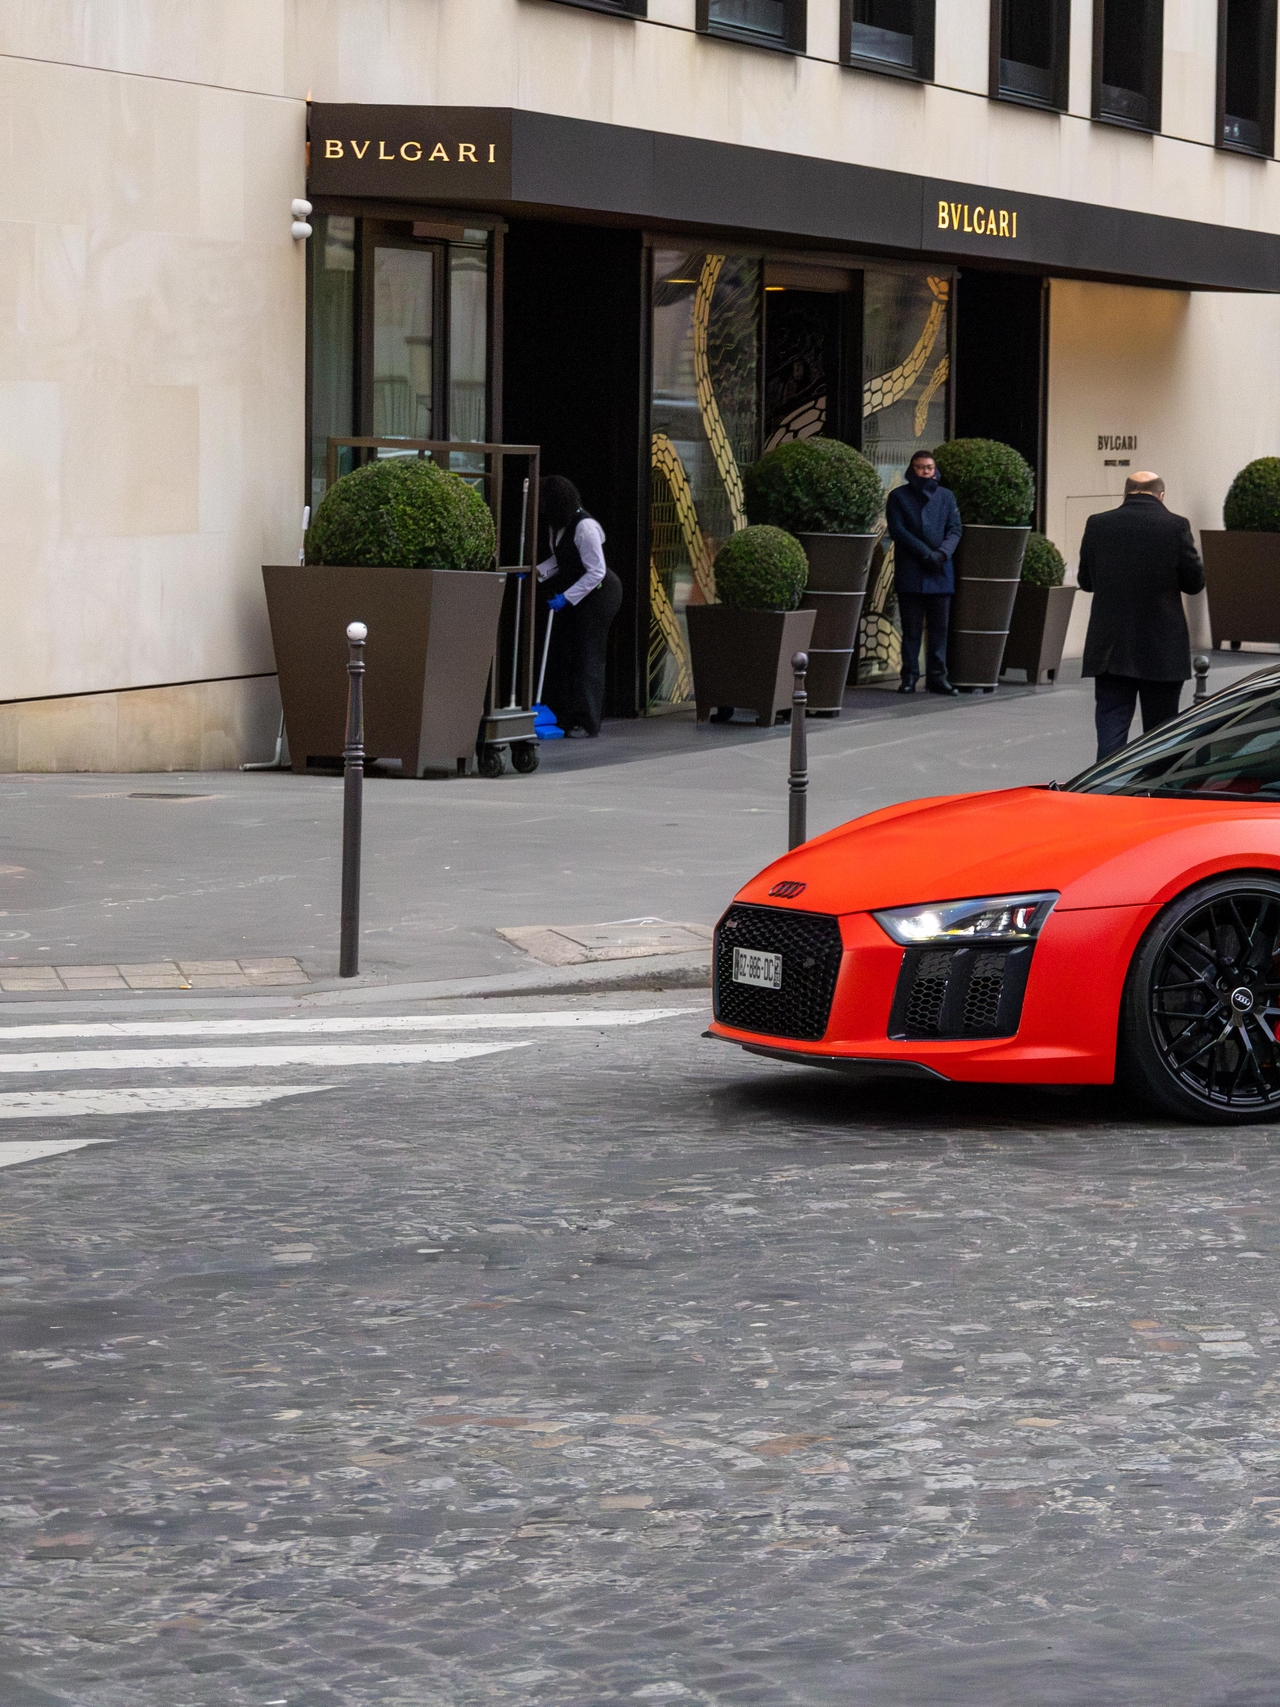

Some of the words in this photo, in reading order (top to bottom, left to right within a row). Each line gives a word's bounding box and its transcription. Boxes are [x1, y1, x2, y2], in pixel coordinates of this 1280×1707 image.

[324, 139, 496, 163] BVLGARI
[937, 200, 1018, 239] BVLGARI
[1097, 435, 1138, 451] BVLGARI
